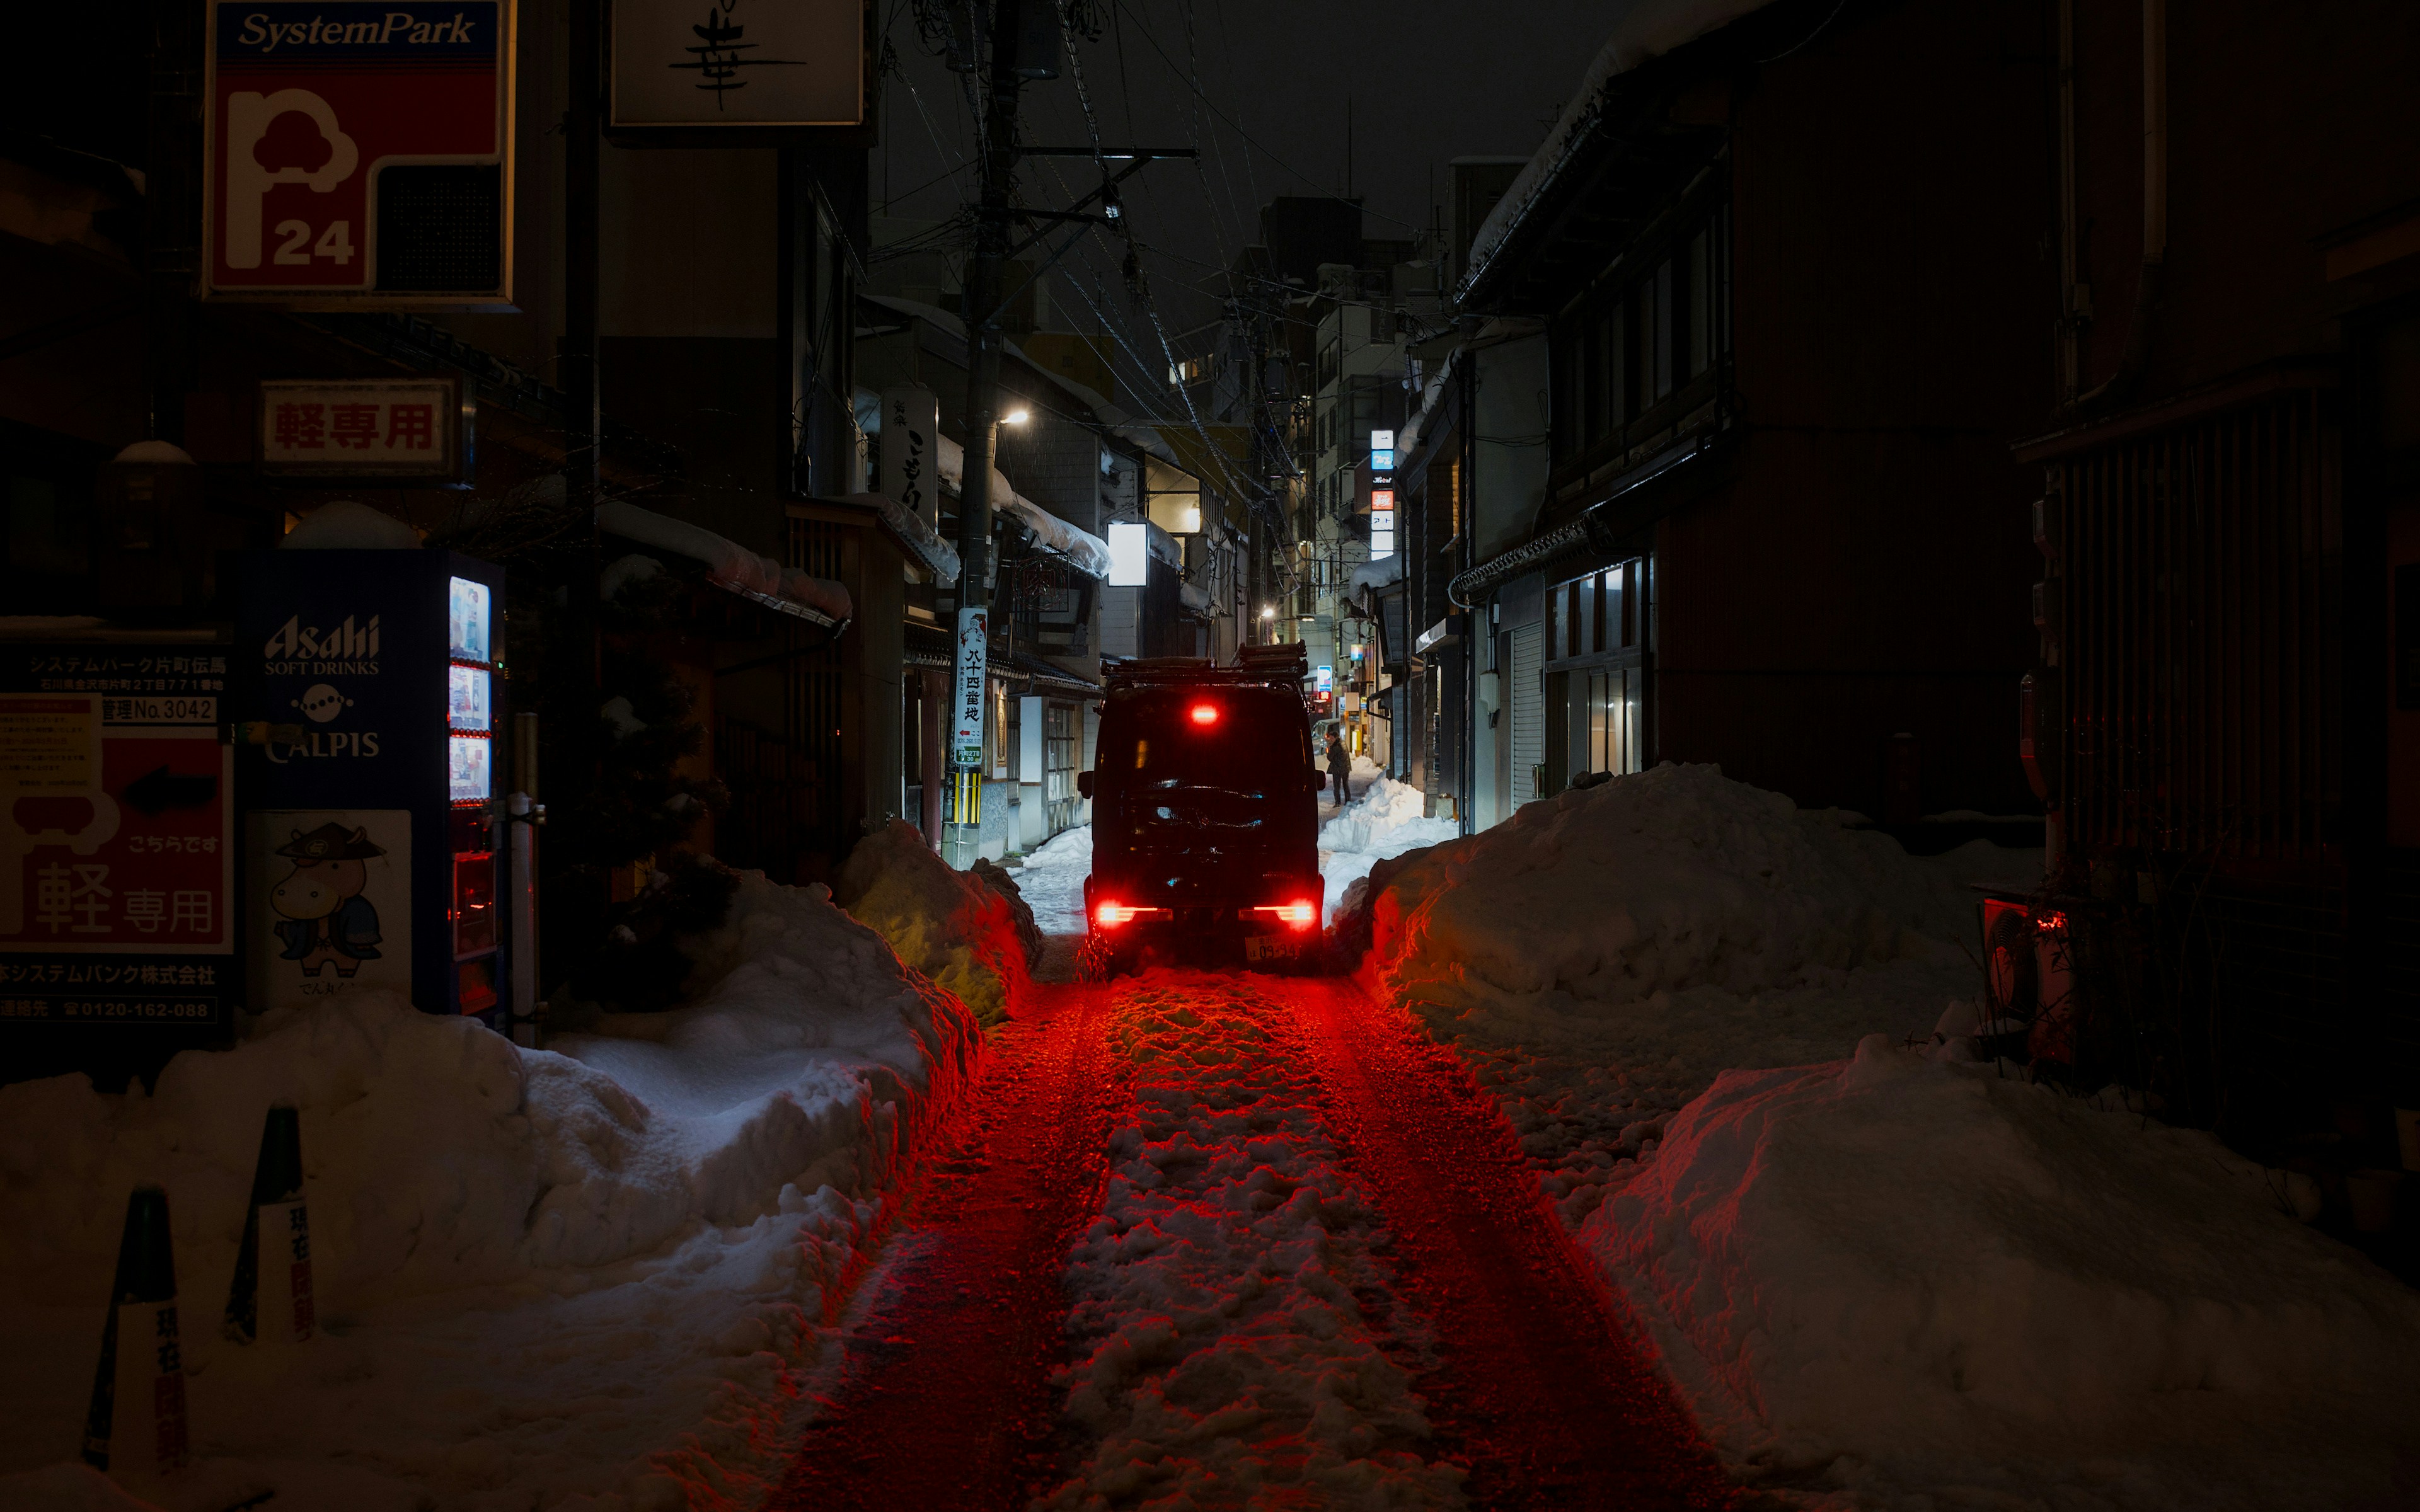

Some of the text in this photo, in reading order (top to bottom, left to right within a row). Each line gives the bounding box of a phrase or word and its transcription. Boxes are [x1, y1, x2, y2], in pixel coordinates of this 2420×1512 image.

[238, 12, 476, 53] SystemPark
[272, 220, 355, 265] 24
[275, 403, 432, 449] 軽専用
[264, 614, 380, 659] Asahi
[265, 662, 379, 675] SOFT DRINKS
[964, 649, 982, 722] 八十四番地
[129, 836, 219, 854] こちらです
[82, 1003, 208, 1017] 0120-162-088
